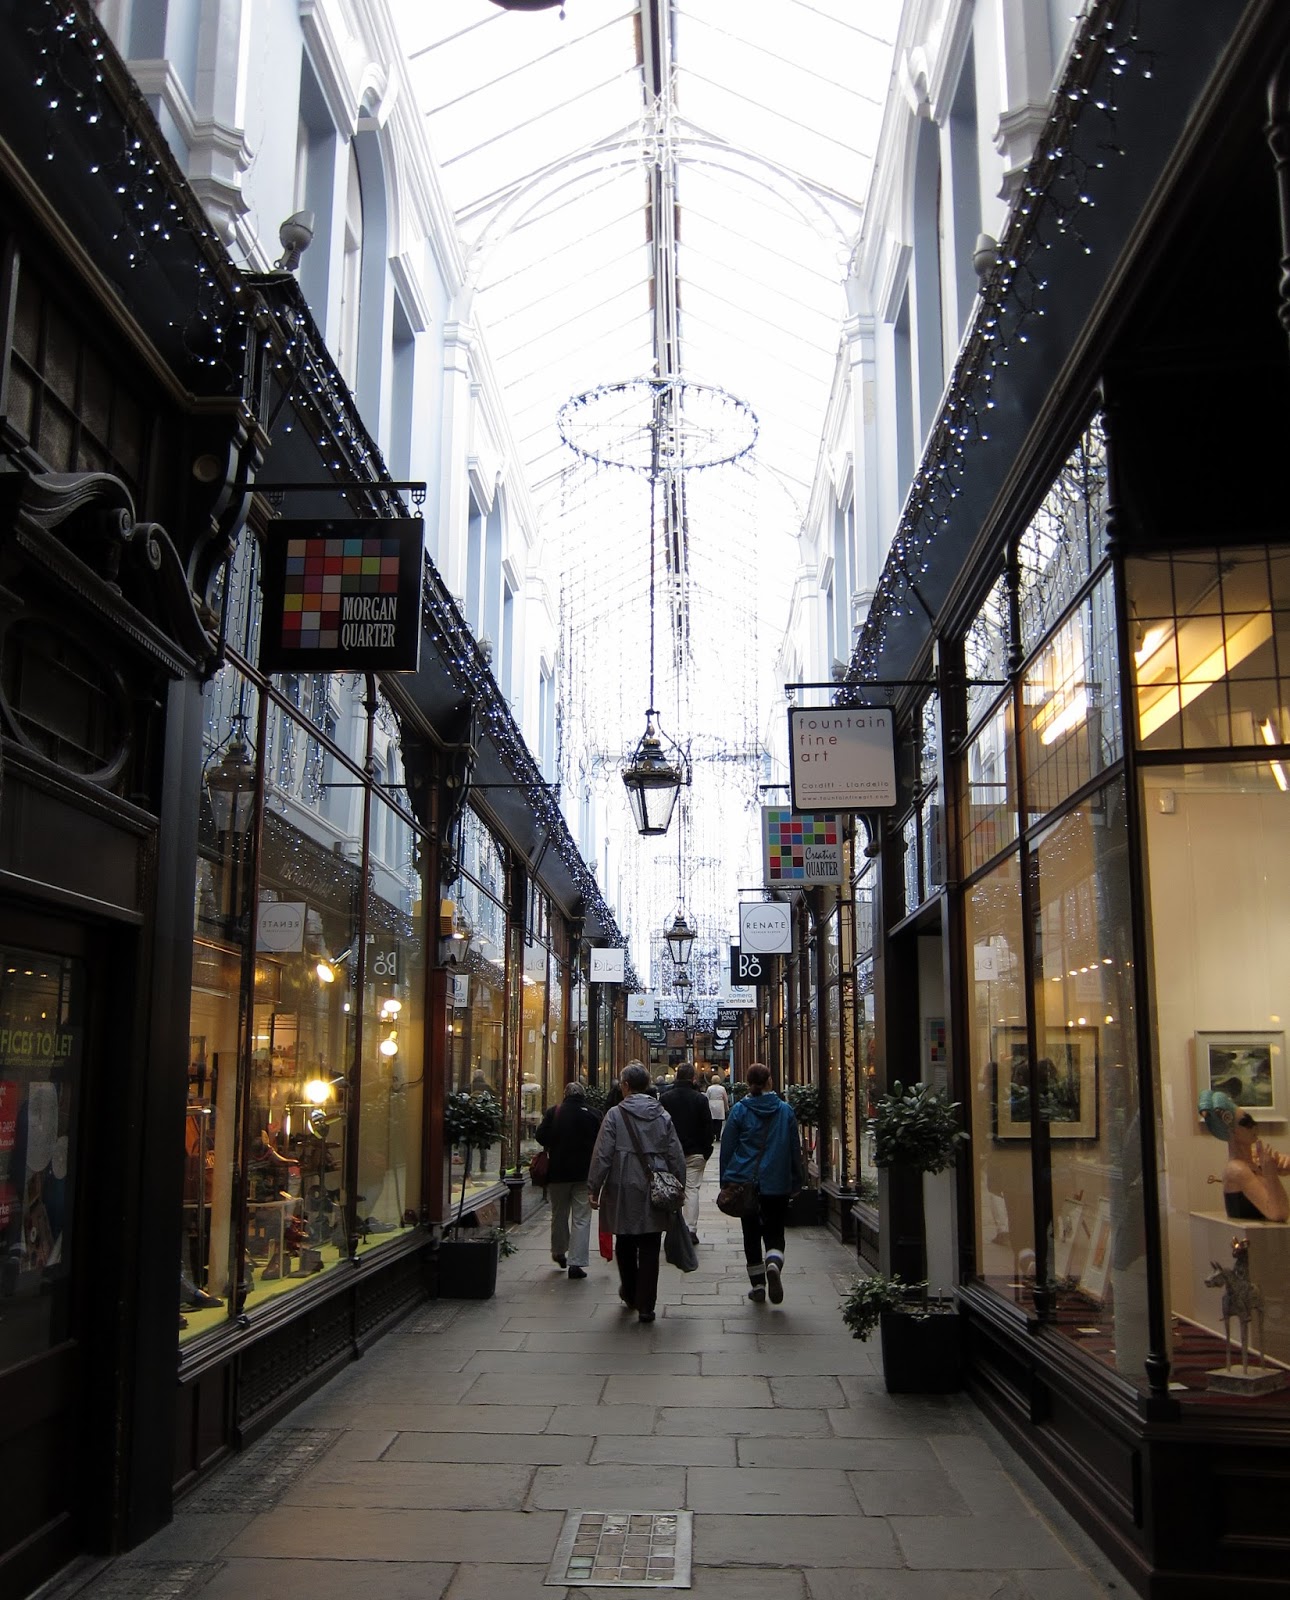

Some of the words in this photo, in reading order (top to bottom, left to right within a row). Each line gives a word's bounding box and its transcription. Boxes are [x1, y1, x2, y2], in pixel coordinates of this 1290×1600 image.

[342, 597, 398, 621] MORGAN
[341, 623, 396, 650] QUARTER
[800, 716, 885, 730] fountain
[800, 734, 838, 746] fine
[801, 750, 828, 762] art
[805, 847, 837, 860] Creative
[805, 861, 838, 878] QUARTER
[746, 921, 786, 929] RENATE
[36, 1032, 52, 1056] TO
[55, 1034, 73, 1056] LET
